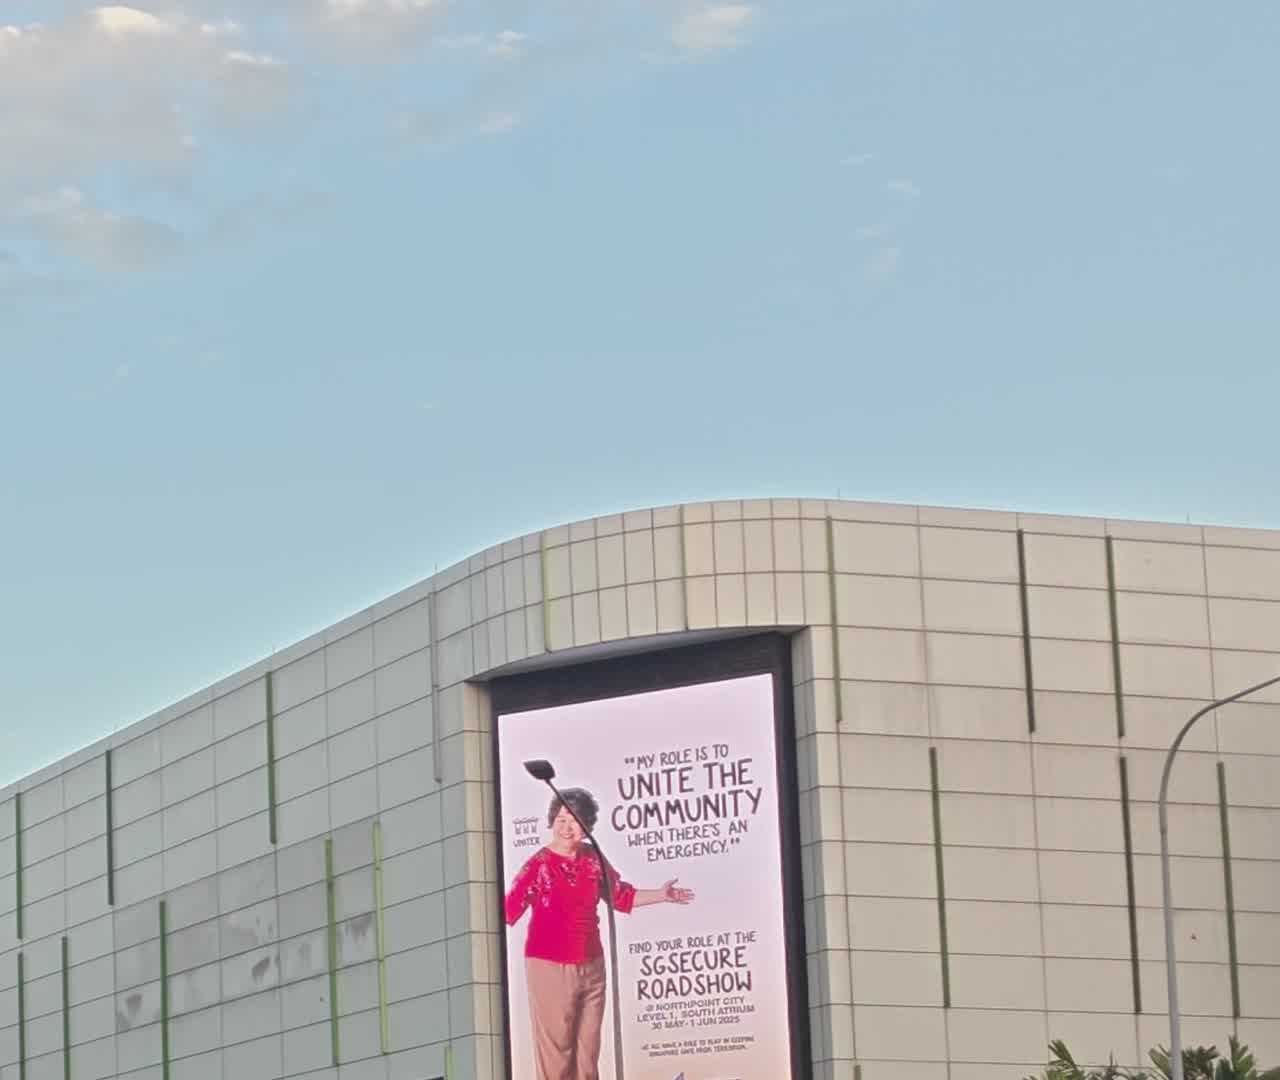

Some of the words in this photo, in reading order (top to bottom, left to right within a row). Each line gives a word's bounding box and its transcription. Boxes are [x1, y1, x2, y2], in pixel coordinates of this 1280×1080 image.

[660, 749, 692, 766] ROLE
[696, 747, 708, 761] IS
[712, 744, 729, 759] TO
[618, 767, 694, 800] UNITE
[703, 758, 753, 789] THE
[611, 787, 762, 832] COMMUNITY
[628, 831, 663, 847] WHEN
[668, 823, 720, 842] THERE'S
[728, 819, 748, 835] AN
[629, 941, 652, 954] FIND
[655, 938, 683, 951] YOUR
[687, 935, 714, 948] ROLE
[717, 932, 731, 946] AT
[734, 930, 757, 944] THE
[640, 946, 747, 976] SGSECURE
[637, 970, 751, 1000] ROADSHOW
[637, 1012, 667, 1023] LEVEL
[681, 1008, 716, 1019] SOUTH
[718, 1005, 755, 1016] ATRIUM
[656, 998, 720, 1011] NORTHPOINT
[722, 996, 745, 1006] CITY
[697, 1017, 717, 1026] JUN
[718, 1016, 740, 1025] 2025
